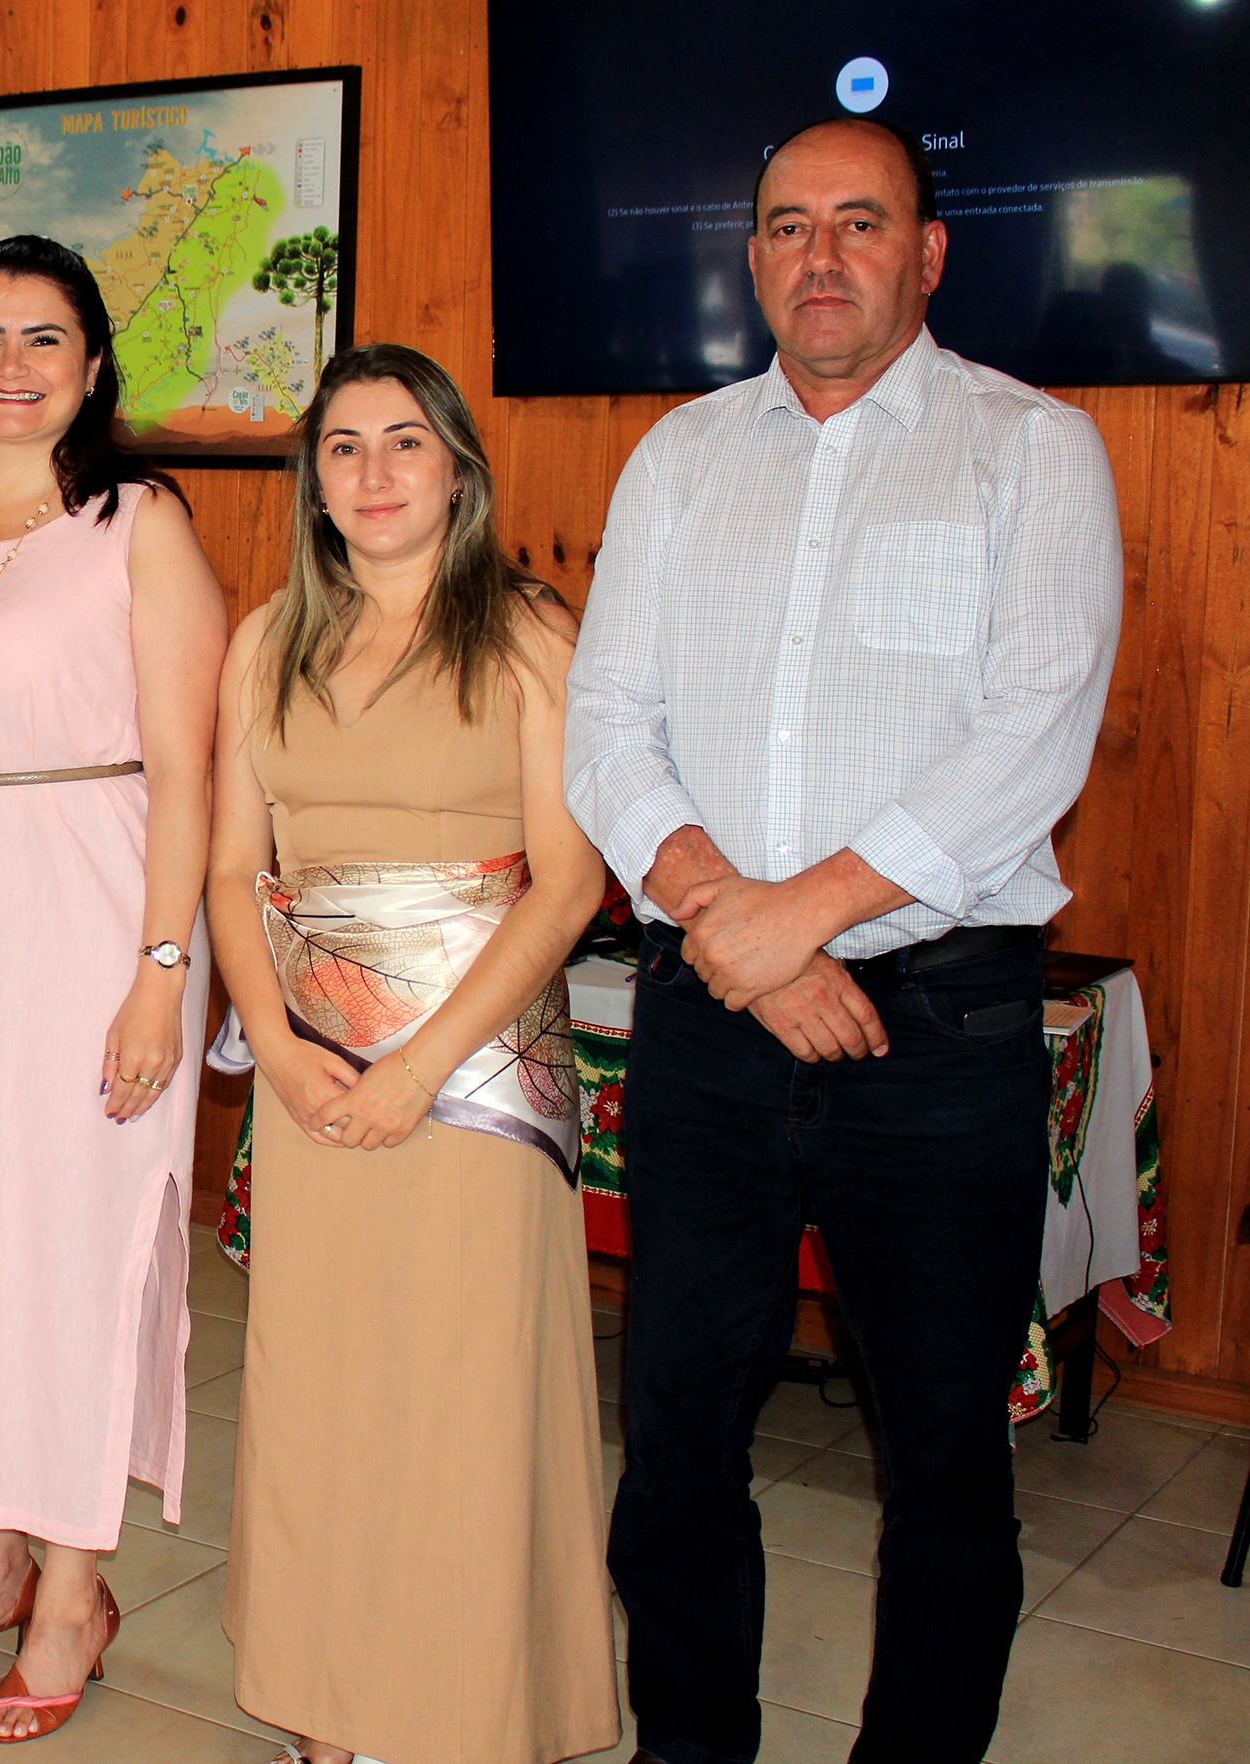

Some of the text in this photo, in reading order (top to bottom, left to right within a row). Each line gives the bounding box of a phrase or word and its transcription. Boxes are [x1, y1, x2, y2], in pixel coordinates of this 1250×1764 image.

[61, 104, 189, 135] MAPA TURÍSTICO
[921, 130, 965, 151] Sinal
[607, 208, 618, 218] (2)
[619, 208, 628, 217] Se
[629, 206, 643, 216] não
[644, 205, 670, 215] houver
[671, 204, 689, 213] sinal
[702, 202, 720, 212] cabo
[721, 201, 730, 210] de
[961, 187, 979, 196] com
[981, 187, 986, 195] o
[988, 183, 1025, 196] provedor
[1027, 182, 1038, 192] de
[1039, 181, 1075, 192] serviços
[1076, 180, 1087, 190] de
[691, 222, 702, 231] (3)
[703, 221, 713, 230] Se
[944, 208, 963, 217] uma
[964, 205, 997, 216] entrada
[998, 202, 1044, 214] conectada.
